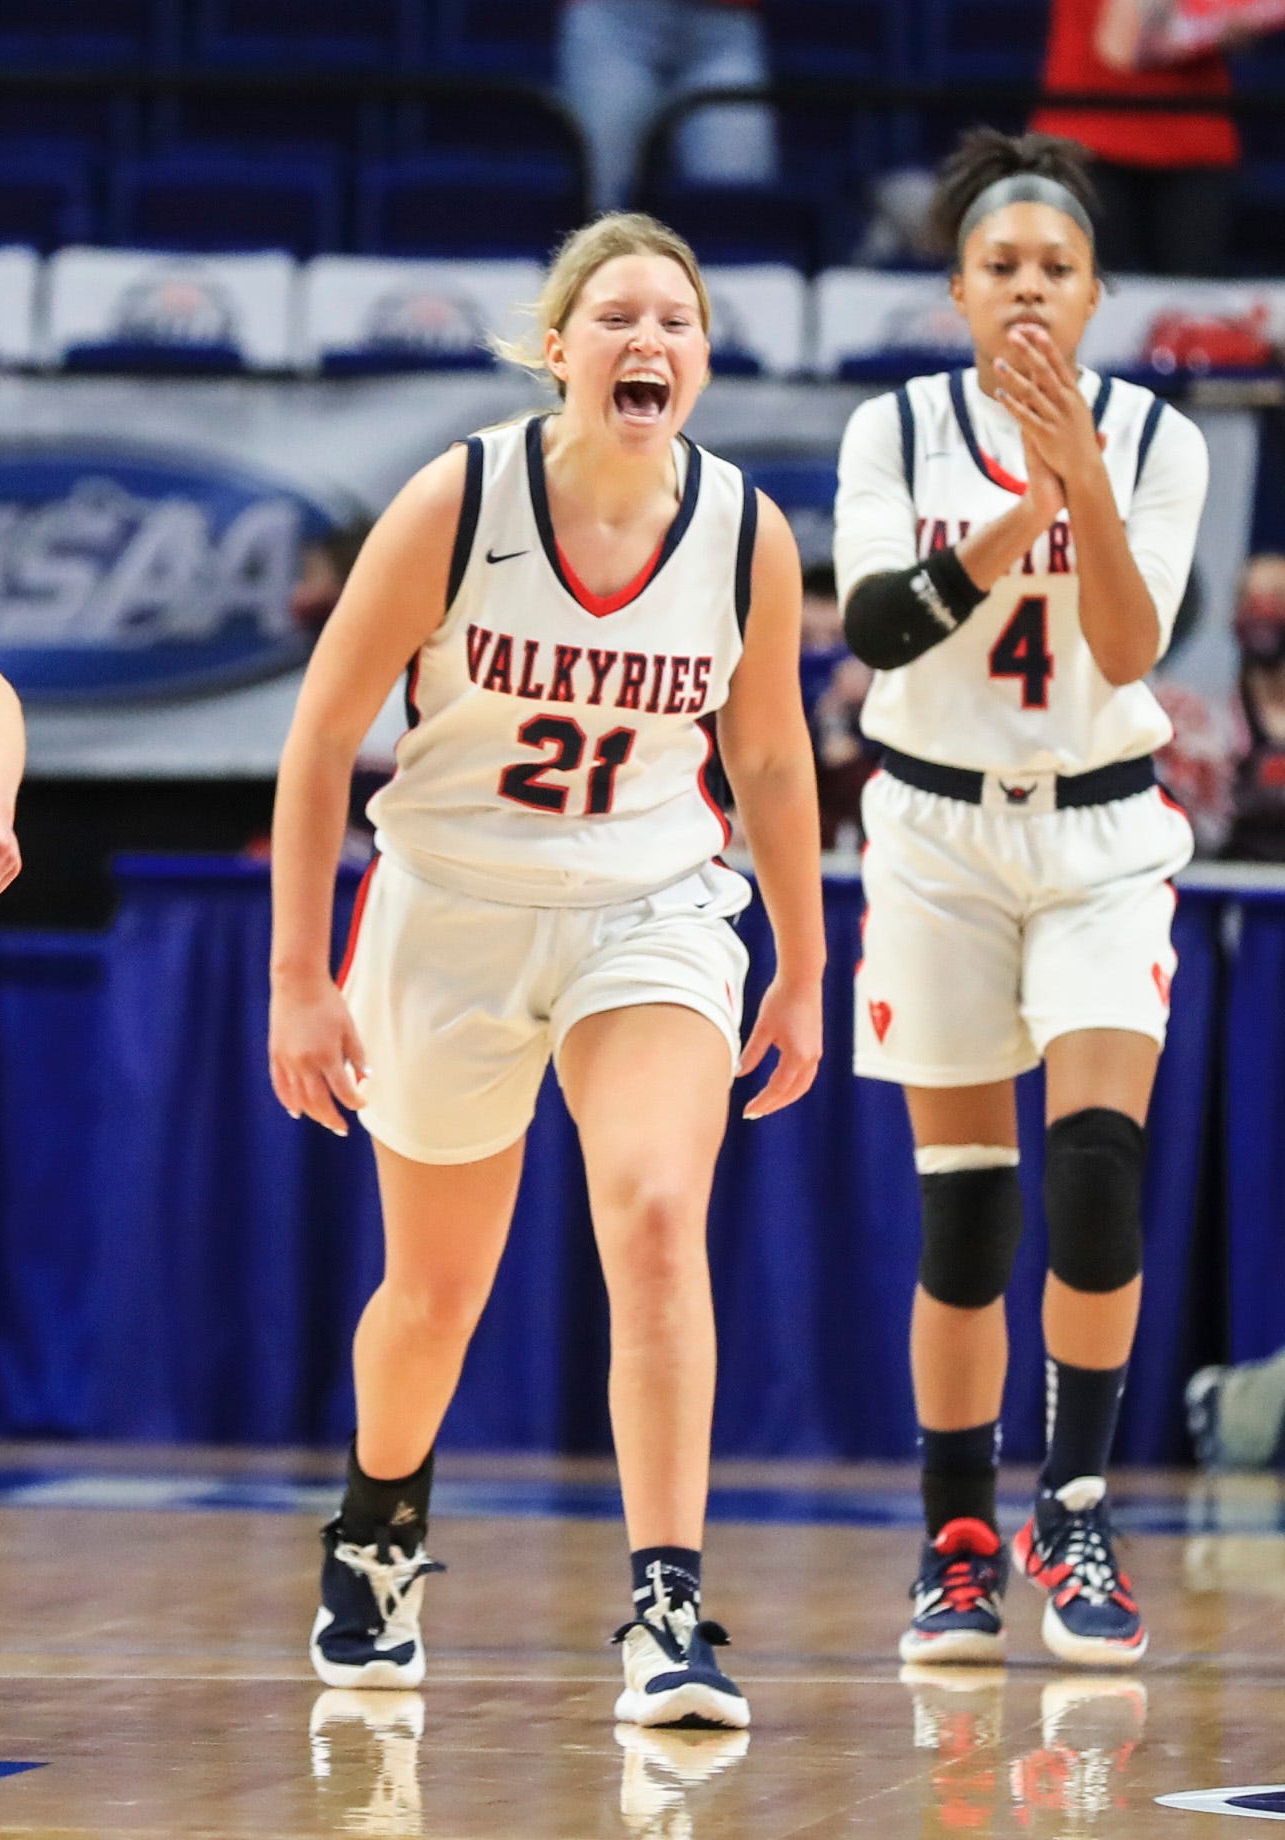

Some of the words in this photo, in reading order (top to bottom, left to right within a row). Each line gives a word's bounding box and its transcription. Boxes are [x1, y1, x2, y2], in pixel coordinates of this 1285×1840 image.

[466, 623, 713, 715] VALKYRIES
[988, 594, 1054, 710] 4
[497, 712, 637, 816] 21
